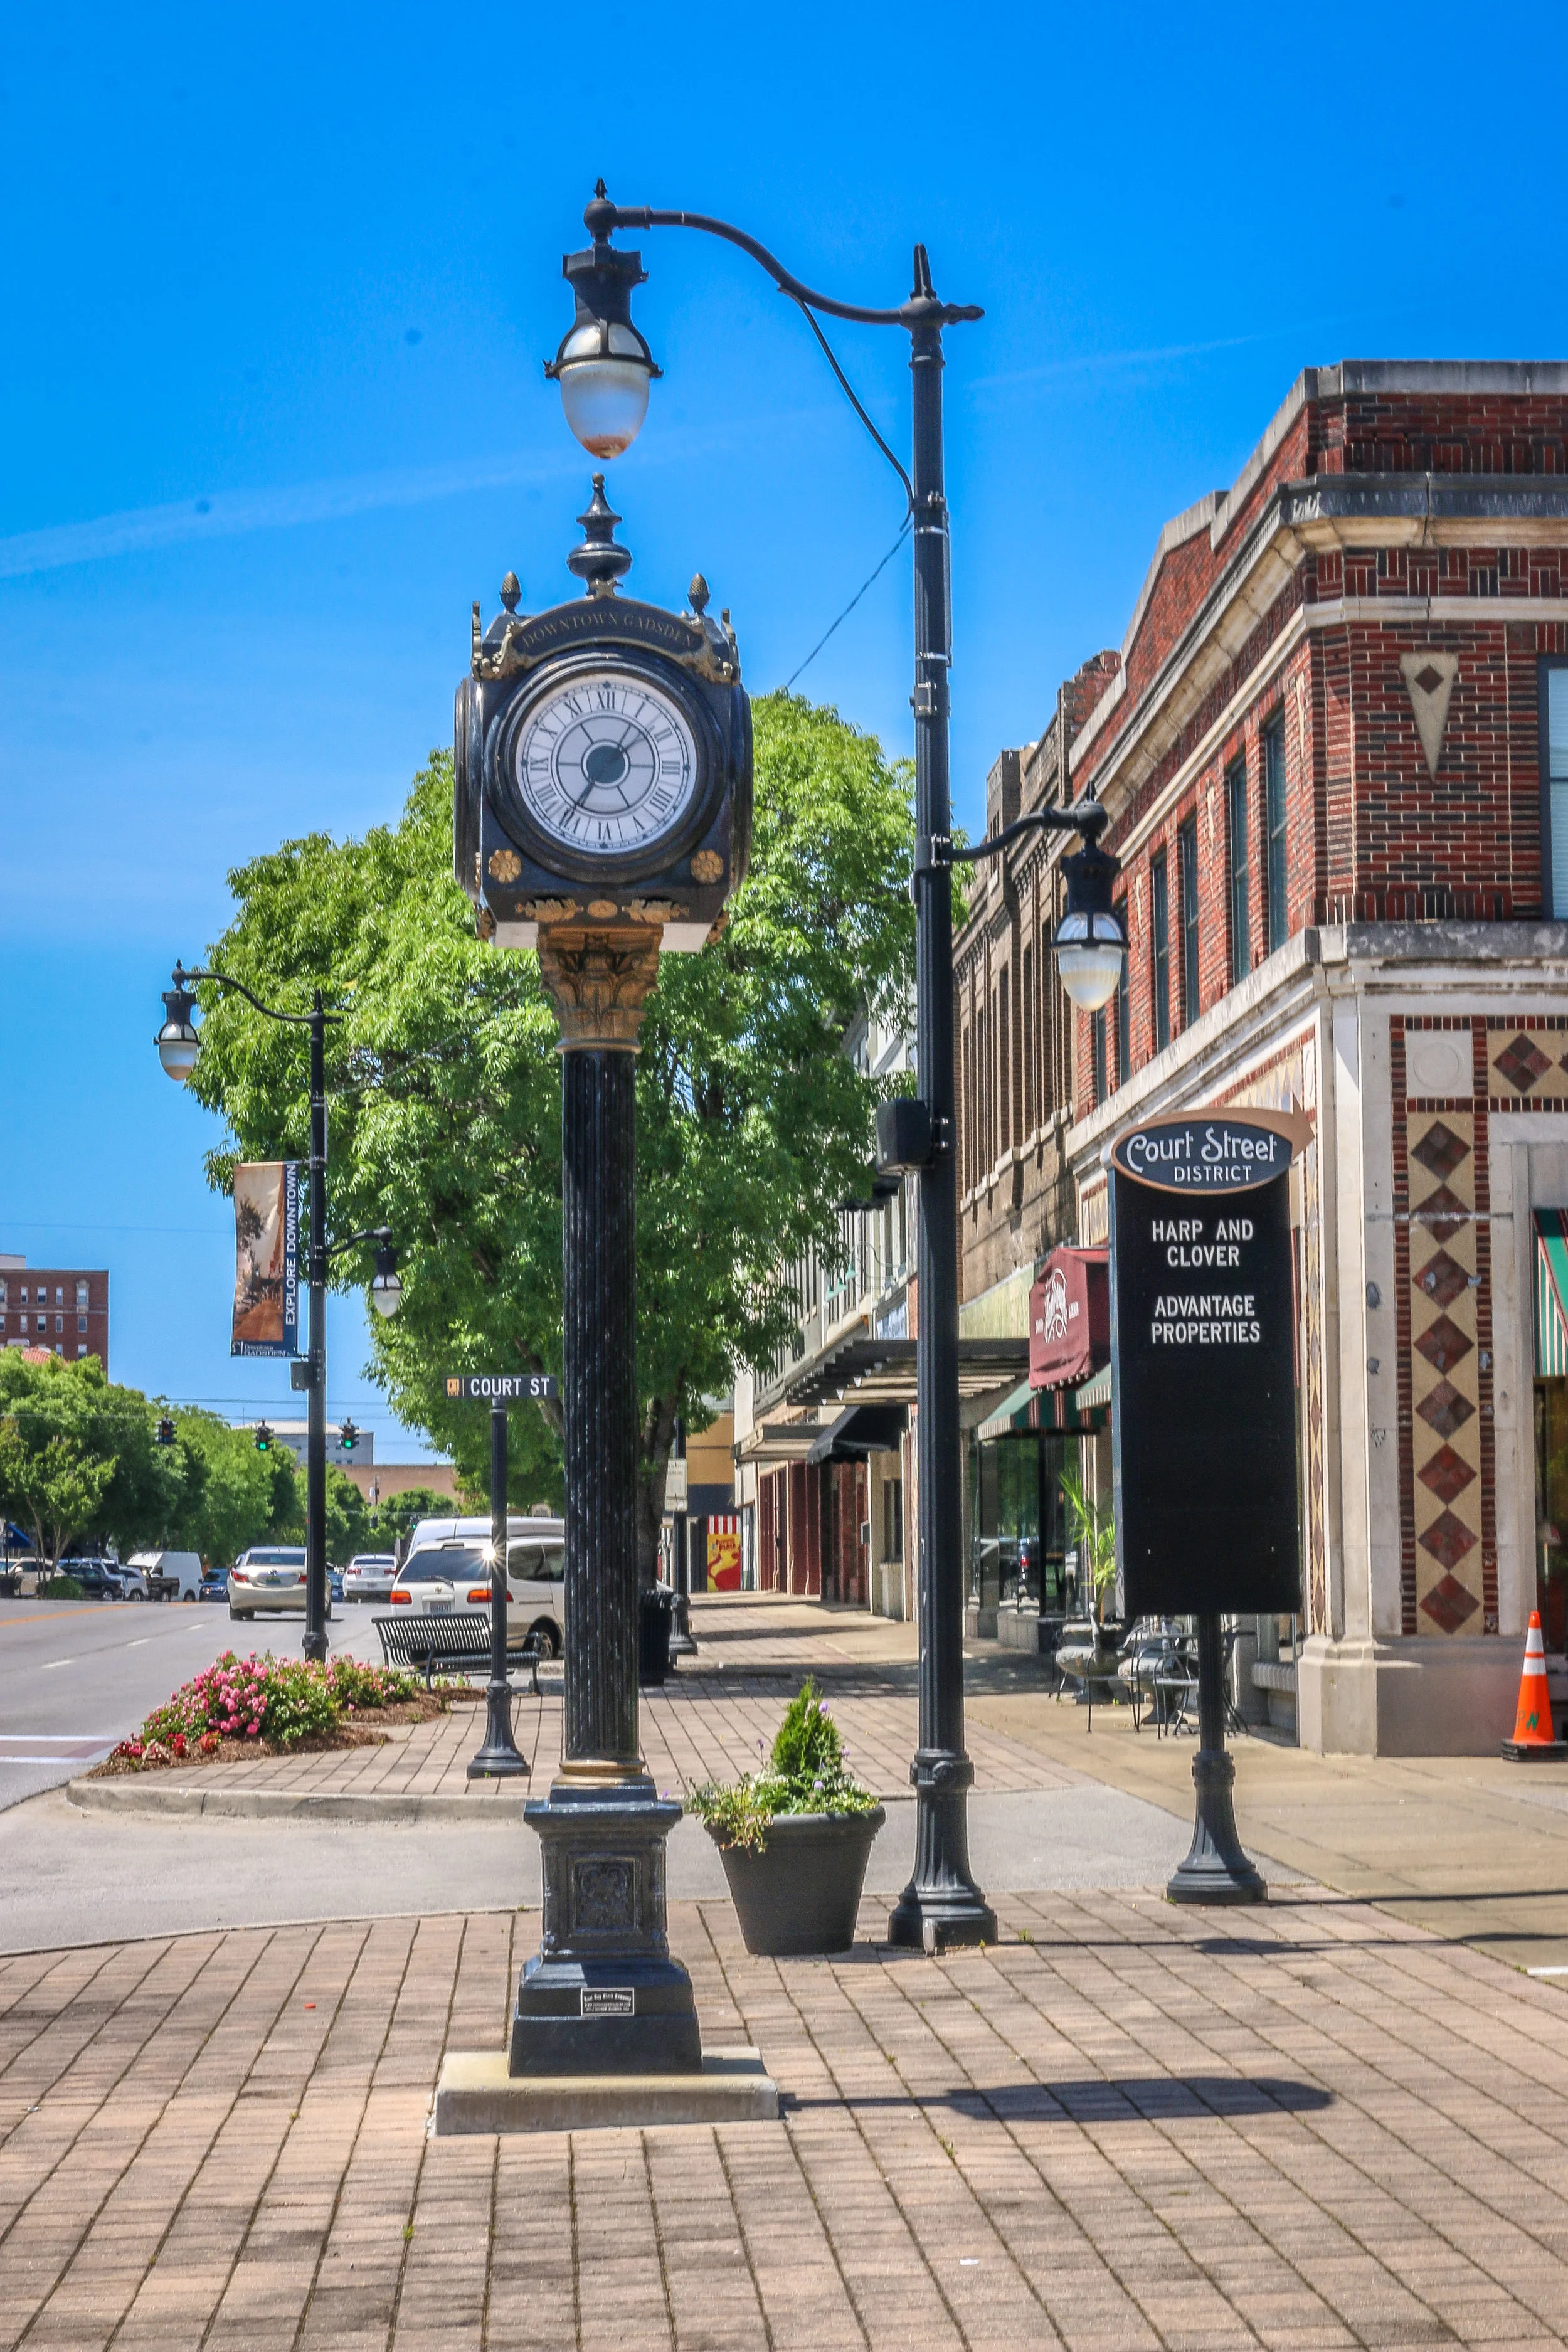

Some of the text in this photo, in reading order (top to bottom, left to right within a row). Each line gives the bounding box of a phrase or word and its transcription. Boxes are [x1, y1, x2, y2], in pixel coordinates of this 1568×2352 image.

[522, 612, 692, 647] DOWNTOWN GADSDEN
[564, 697, 582, 718] XI
[597, 691, 615, 709] XII
[539, 723, 558, 741] X
[654, 726, 673, 743] II
[529, 756, 549, 771] IX
[662, 761, 681, 775] III
[535, 783, 559, 813] VIII
[598, 821, 611, 840] VI
[632, 815, 646, 833] V
[1127, 1126, 1277, 1173] Court Street
[1174, 1165, 1252, 1182] DISTRICT
[1152, 1219, 1253, 1242] HARP AND
[286, 1165, 297, 1325] EXPLORE DOWNTOWN
[1167, 1245, 1240, 1267] CLOVER
[1154, 1295, 1255, 1318] ADVANTAGE
[1152, 1321, 1261, 1343] PROPERTIES
[470, 1377, 521, 1396] COURT
[530, 1377, 549, 1396] ST
